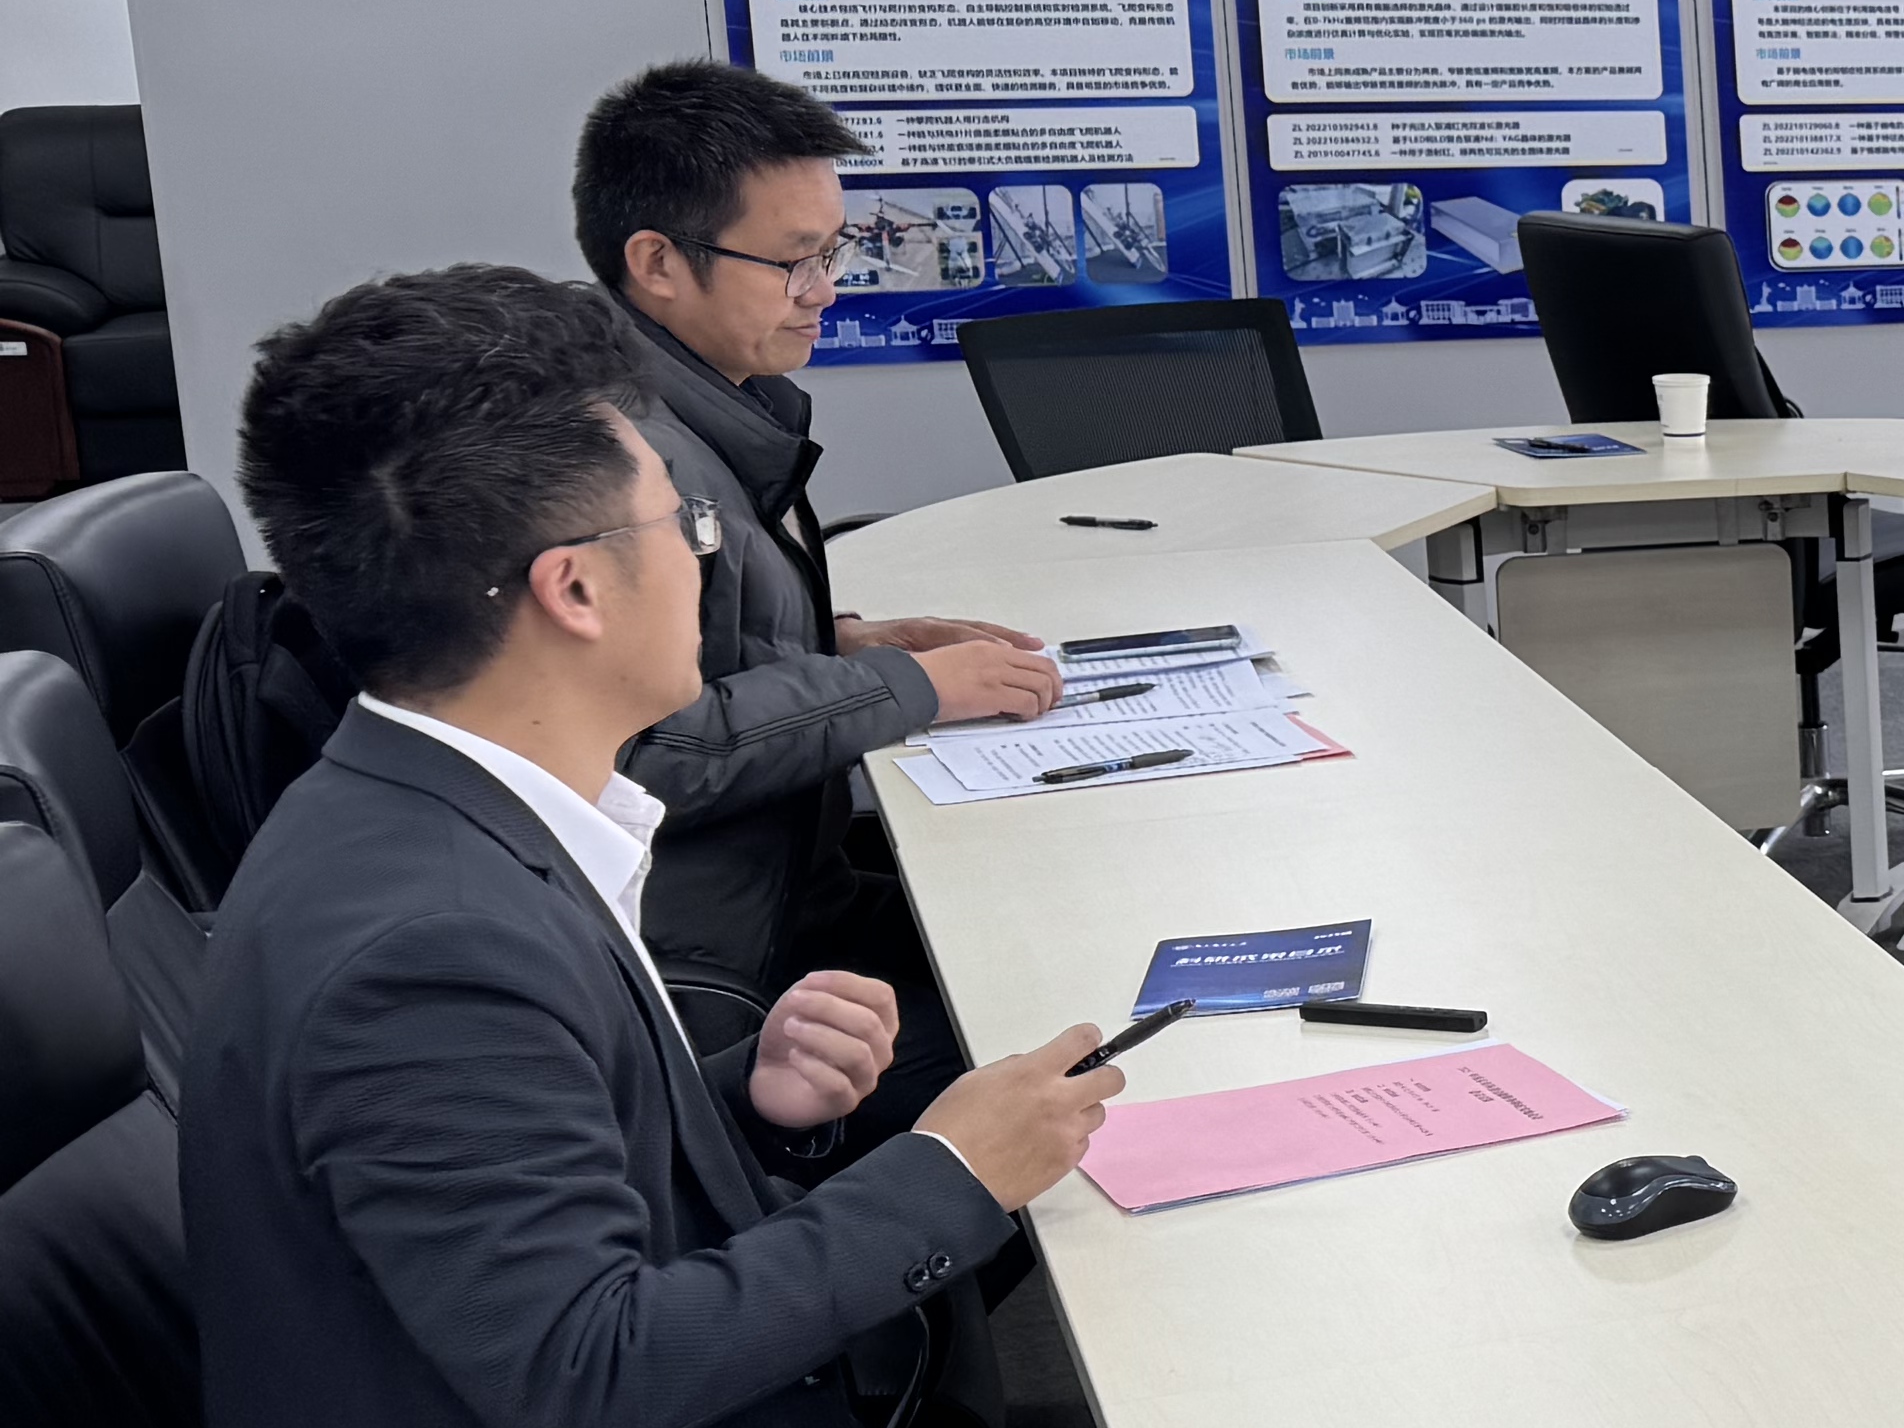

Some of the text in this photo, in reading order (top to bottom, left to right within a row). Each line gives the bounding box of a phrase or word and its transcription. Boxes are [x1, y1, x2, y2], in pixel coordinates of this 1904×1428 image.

[780, 49, 835, 63] 市场前景
[1284, 47, 1335, 61] 市场前景
[1755, 47, 1801, 61] 市场前景
